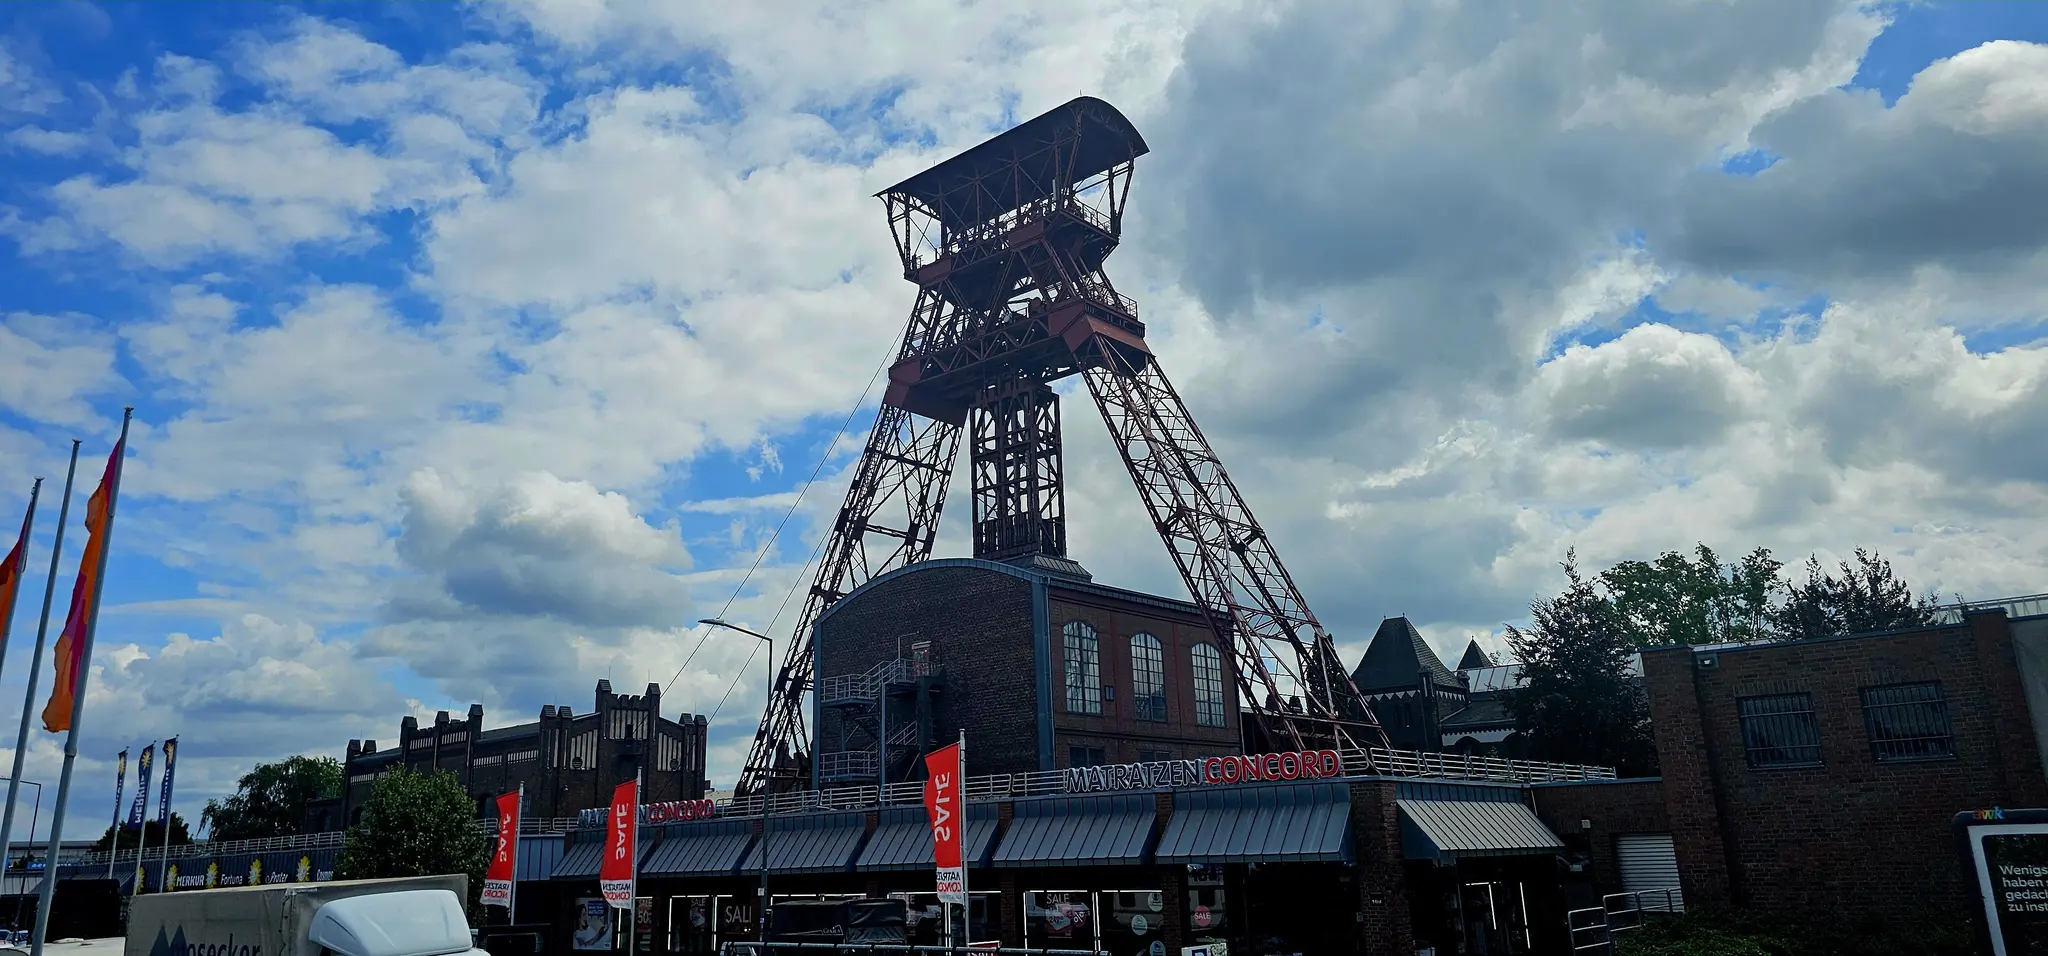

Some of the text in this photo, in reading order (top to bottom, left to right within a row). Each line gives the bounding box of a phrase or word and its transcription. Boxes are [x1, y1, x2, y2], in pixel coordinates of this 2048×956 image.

[1065, 750, 1343, 793] MATRATZEN CONCORD
[648, 800, 715, 823] CONCORD
[176, 874, 205, 887] MERKUR
[2003, 877, 2044, 888] haben
[691, 898, 707, 907] SALE
[1046, 893, 1070, 904] SALE
[2008, 903, 2024, 912] zu
[1194, 911, 1211, 920] SALE
